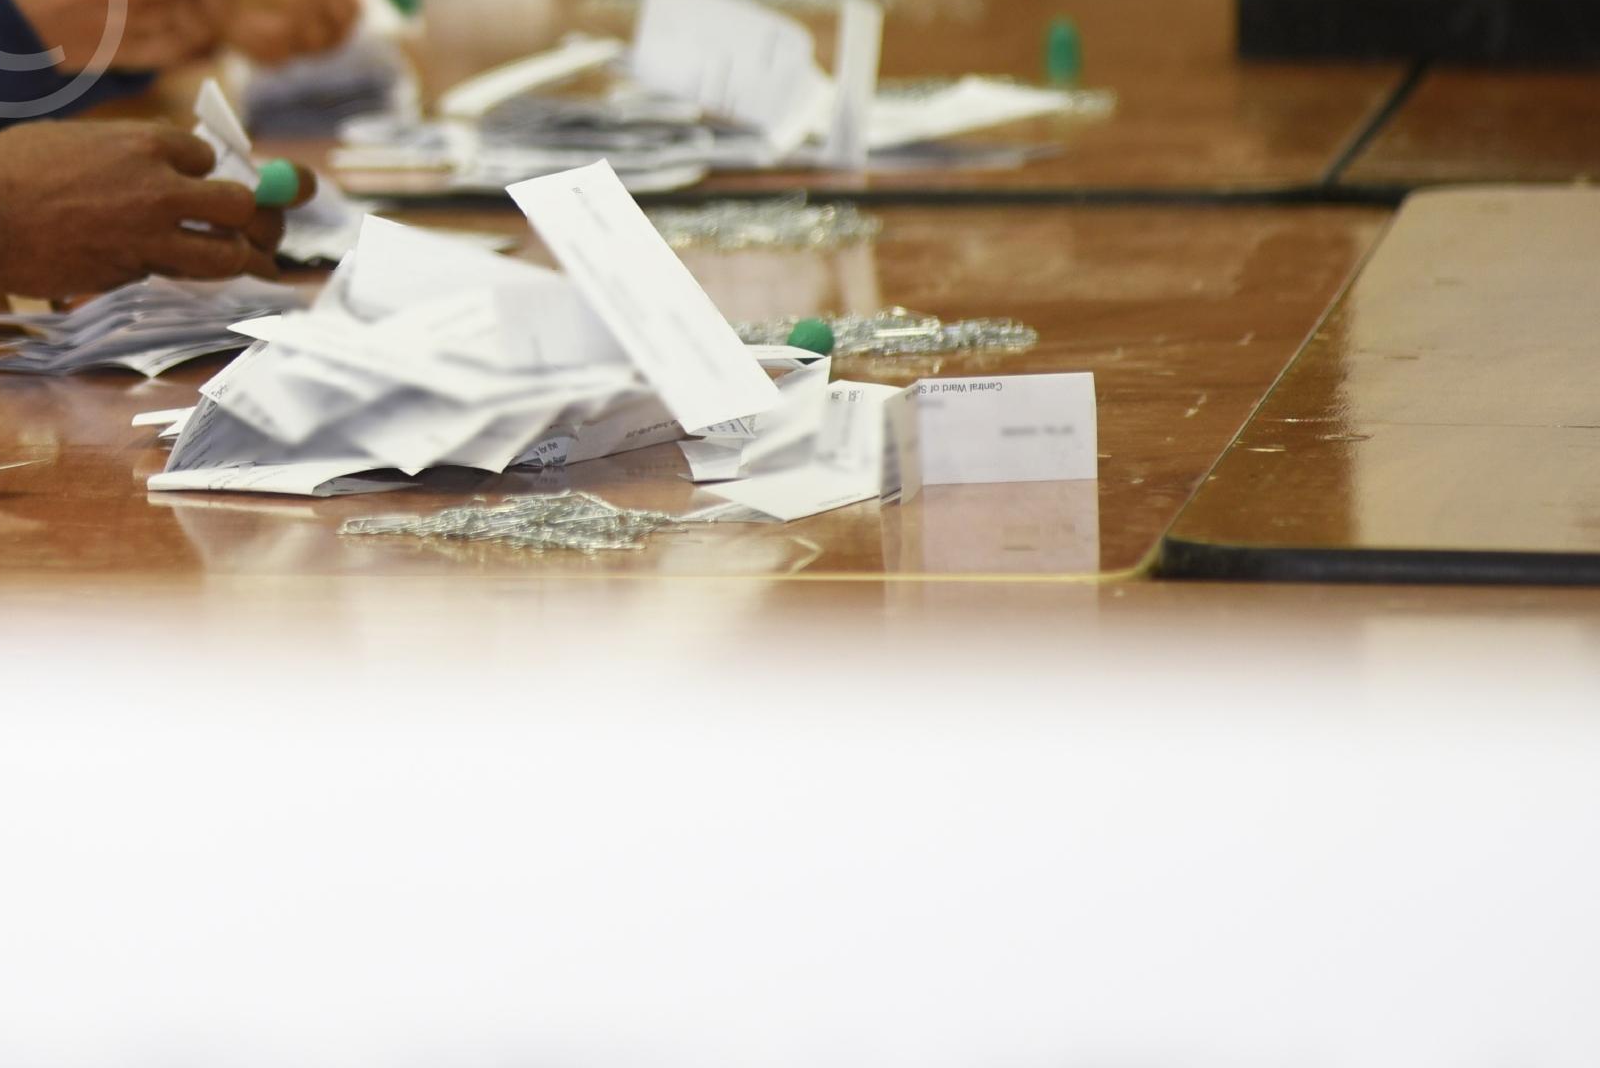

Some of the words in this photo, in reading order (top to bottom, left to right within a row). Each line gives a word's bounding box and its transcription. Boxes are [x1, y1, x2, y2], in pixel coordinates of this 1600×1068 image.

[930, 384, 940, 392] of
[942, 382, 967, 393] Ward
[969, 381, 1003, 392] Central
